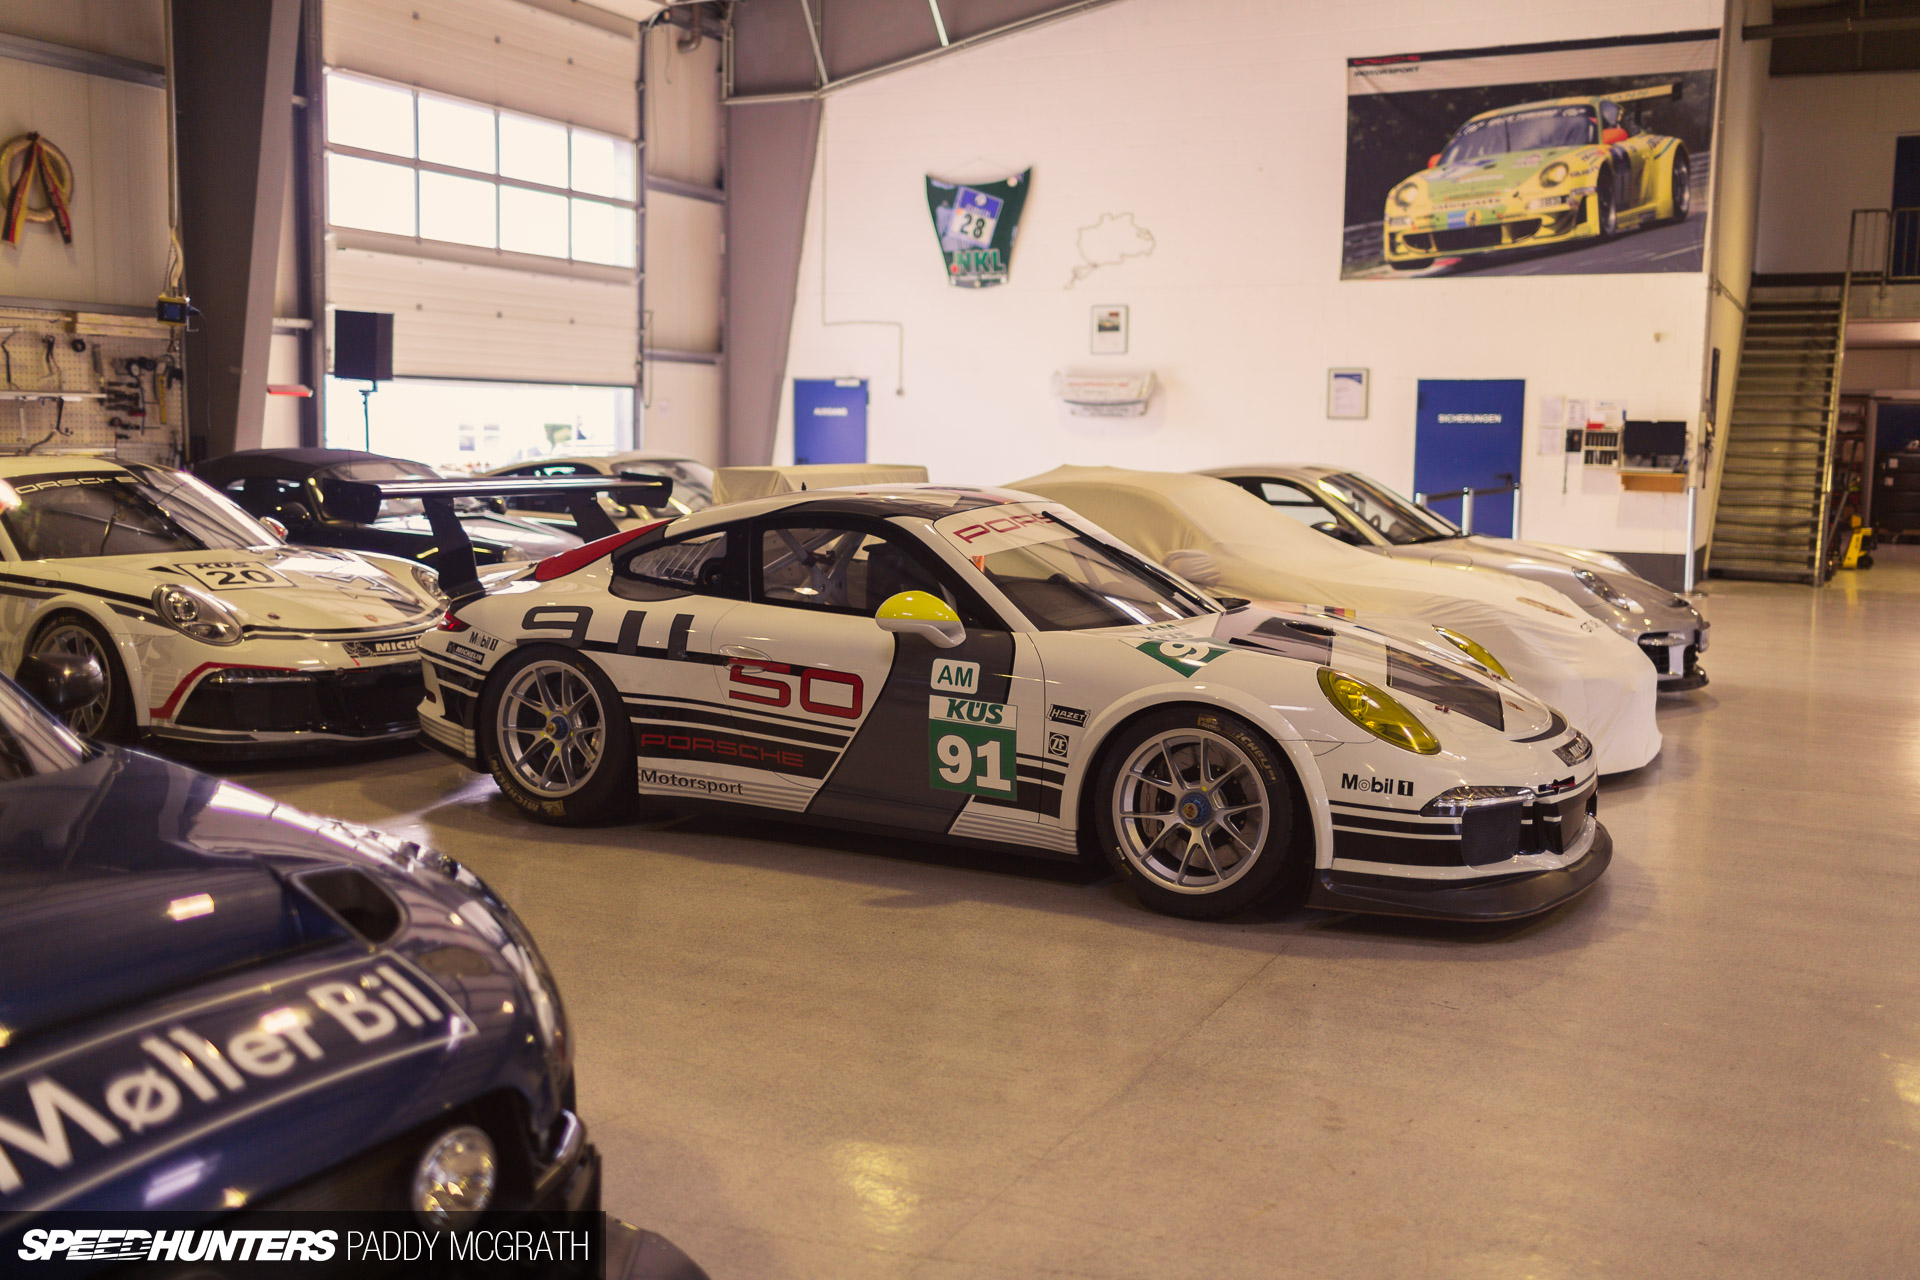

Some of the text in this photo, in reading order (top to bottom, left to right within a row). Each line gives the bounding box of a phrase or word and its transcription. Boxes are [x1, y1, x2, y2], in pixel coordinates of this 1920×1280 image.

[959, 212, 986, 239] 28
[1437, 413, 1502, 424] SICHERUNGEN
[14, 476, 139, 494] ORSCHE
[206, 570, 275, 585] 20
[374, 635, 419, 652] MICH
[469, 631, 499, 651] Mobil 1
[516, 606, 695, 659] 911
[455, 646, 484, 661] MICHELIN
[729, 658, 864, 719] 50
[937, 664, 974, 688] AM
[946, 698, 1004, 725] KÜS
[1051, 708, 1086, 721] HAZET
[641, 733, 805, 768] PORSCHE
[1051, 737, 1067, 752] ZF
[1231, 732, 1277, 781] ICHELIN
[936, 734, 1012, 792] 91
[640, 769, 744, 796] Motorsport
[1341, 772, 1414, 797] Mobil 1
[0, 963, 444, 1195] Møller Bil
